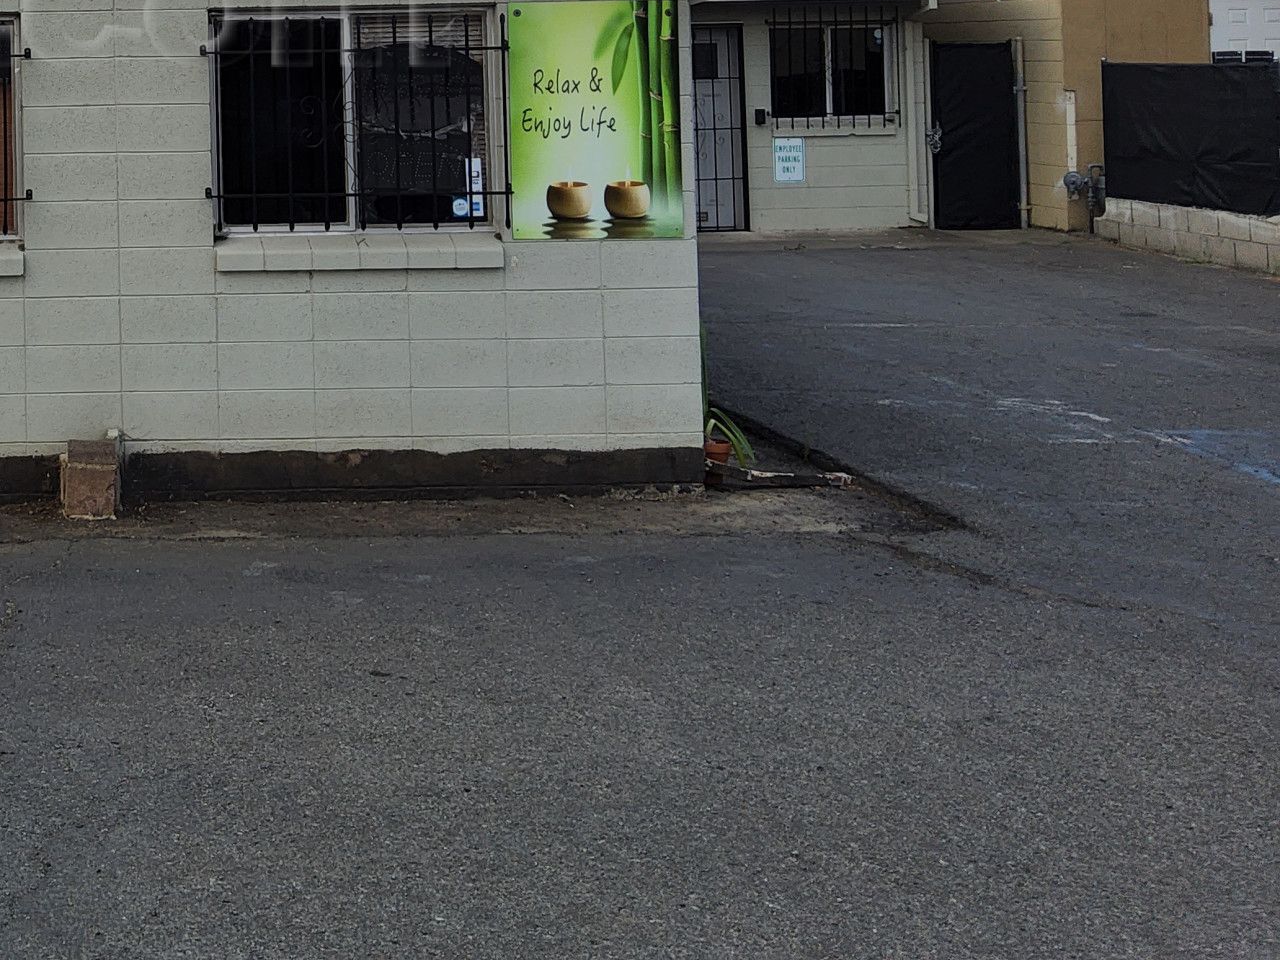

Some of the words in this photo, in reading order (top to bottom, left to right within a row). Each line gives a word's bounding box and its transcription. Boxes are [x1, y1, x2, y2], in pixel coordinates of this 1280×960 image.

[533, 68, 581, 94] Relax
[589, 67, 603, 93] &
[521, 106, 571, 139] Enjoy
[580, 105, 617, 138] Life
